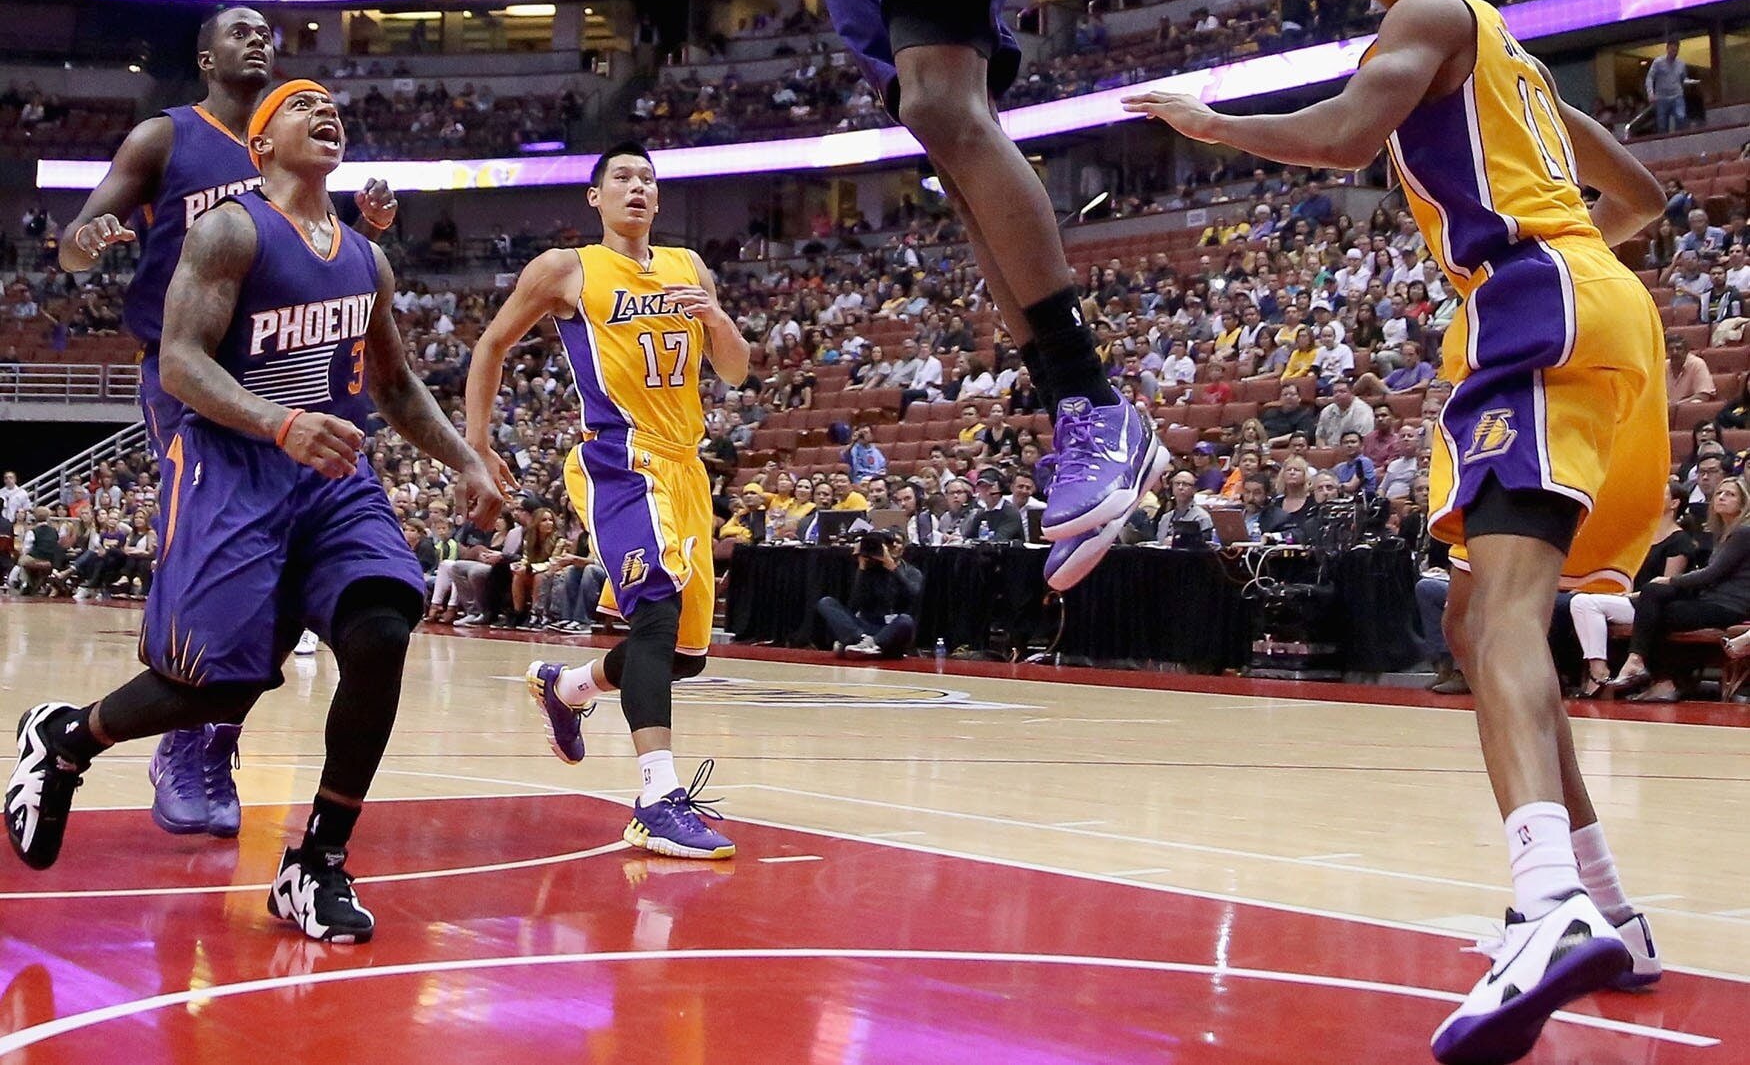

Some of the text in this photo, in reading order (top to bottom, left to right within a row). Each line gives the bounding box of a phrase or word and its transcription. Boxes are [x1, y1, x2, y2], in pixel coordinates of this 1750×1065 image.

[1517, 75, 1580, 185] 11
[347, 339, 366, 396] 3
[637, 331, 690, 389] 17
